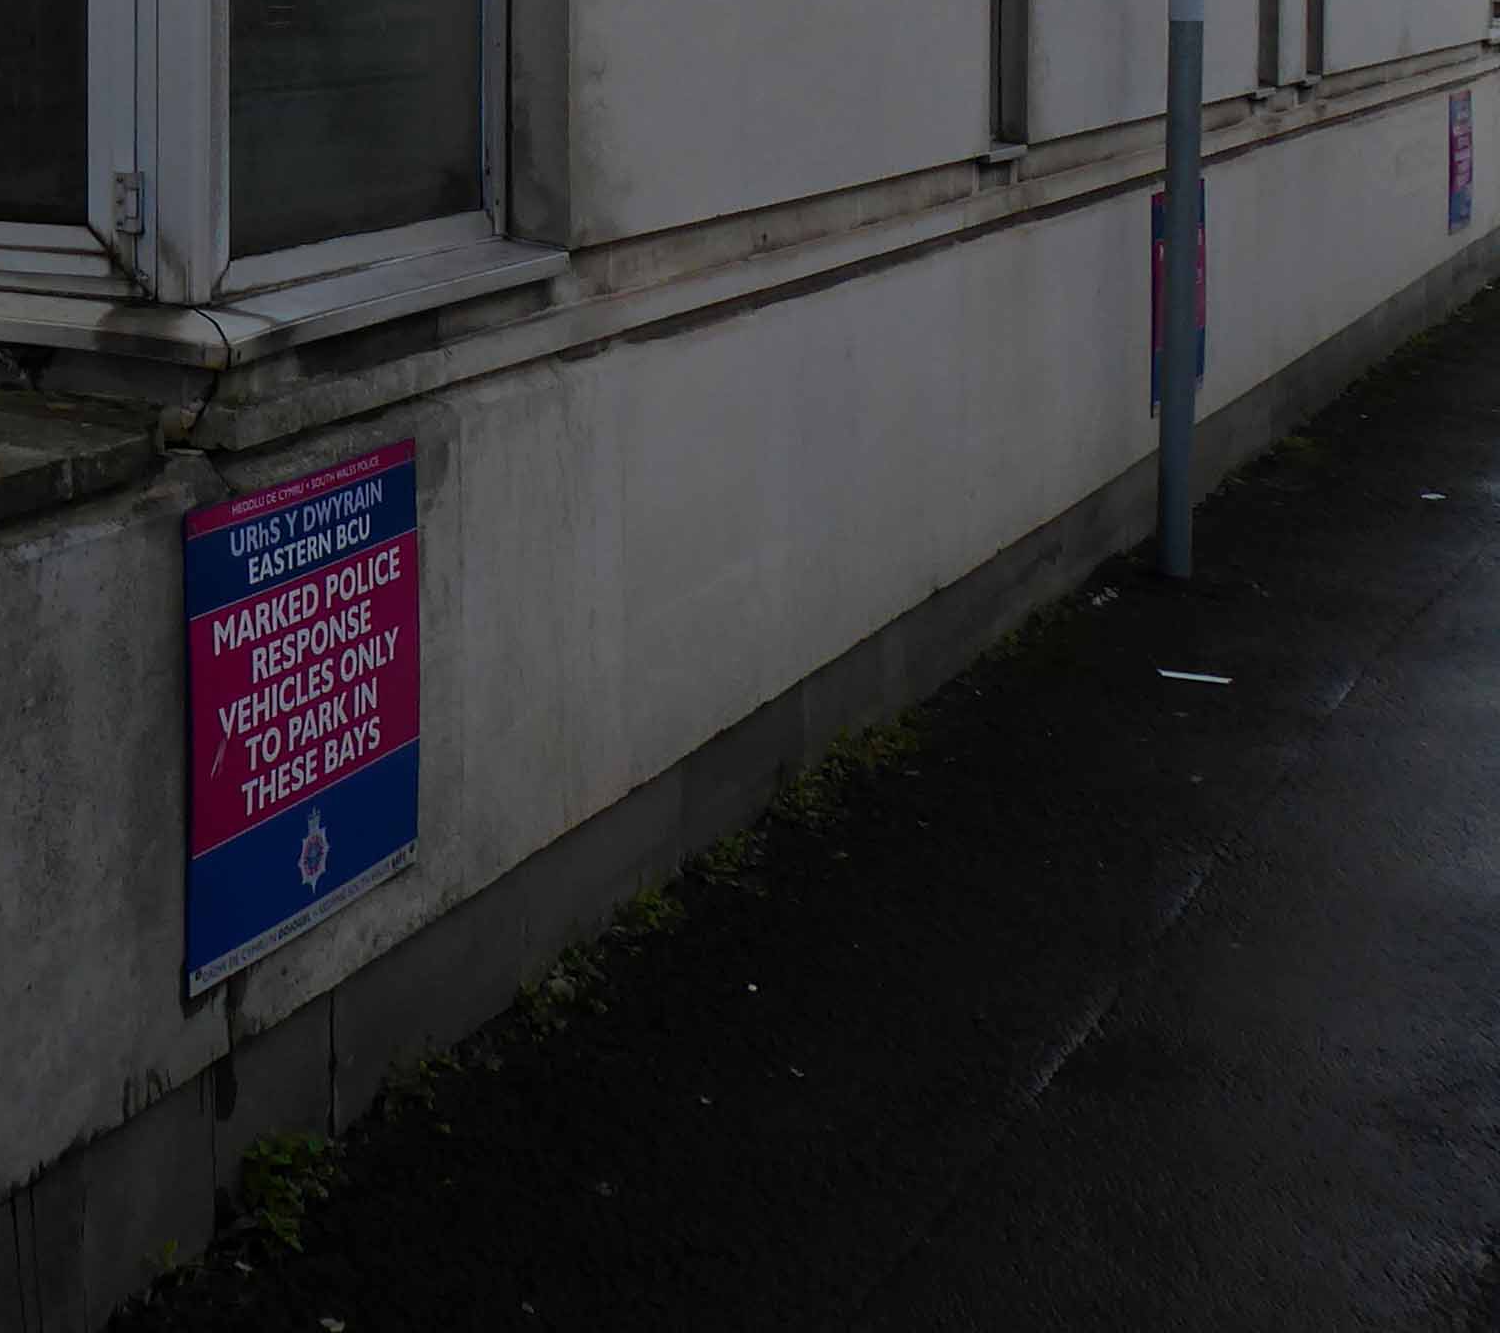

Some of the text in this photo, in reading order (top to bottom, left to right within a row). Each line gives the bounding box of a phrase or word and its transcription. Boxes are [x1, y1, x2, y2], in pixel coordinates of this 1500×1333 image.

[231, 479, 382, 557] URhS Y DWYRAIN
[249, 514, 370, 584] EASTERN BCU
[213, 546, 400, 655] MARKED POLICE
[252, 600, 371, 683] RESPONSE
[219, 626, 399, 740] VEHICLES ONLY
[245, 678, 377, 771] TO PARK IN
[242, 717, 380, 816] THESE BAYS
